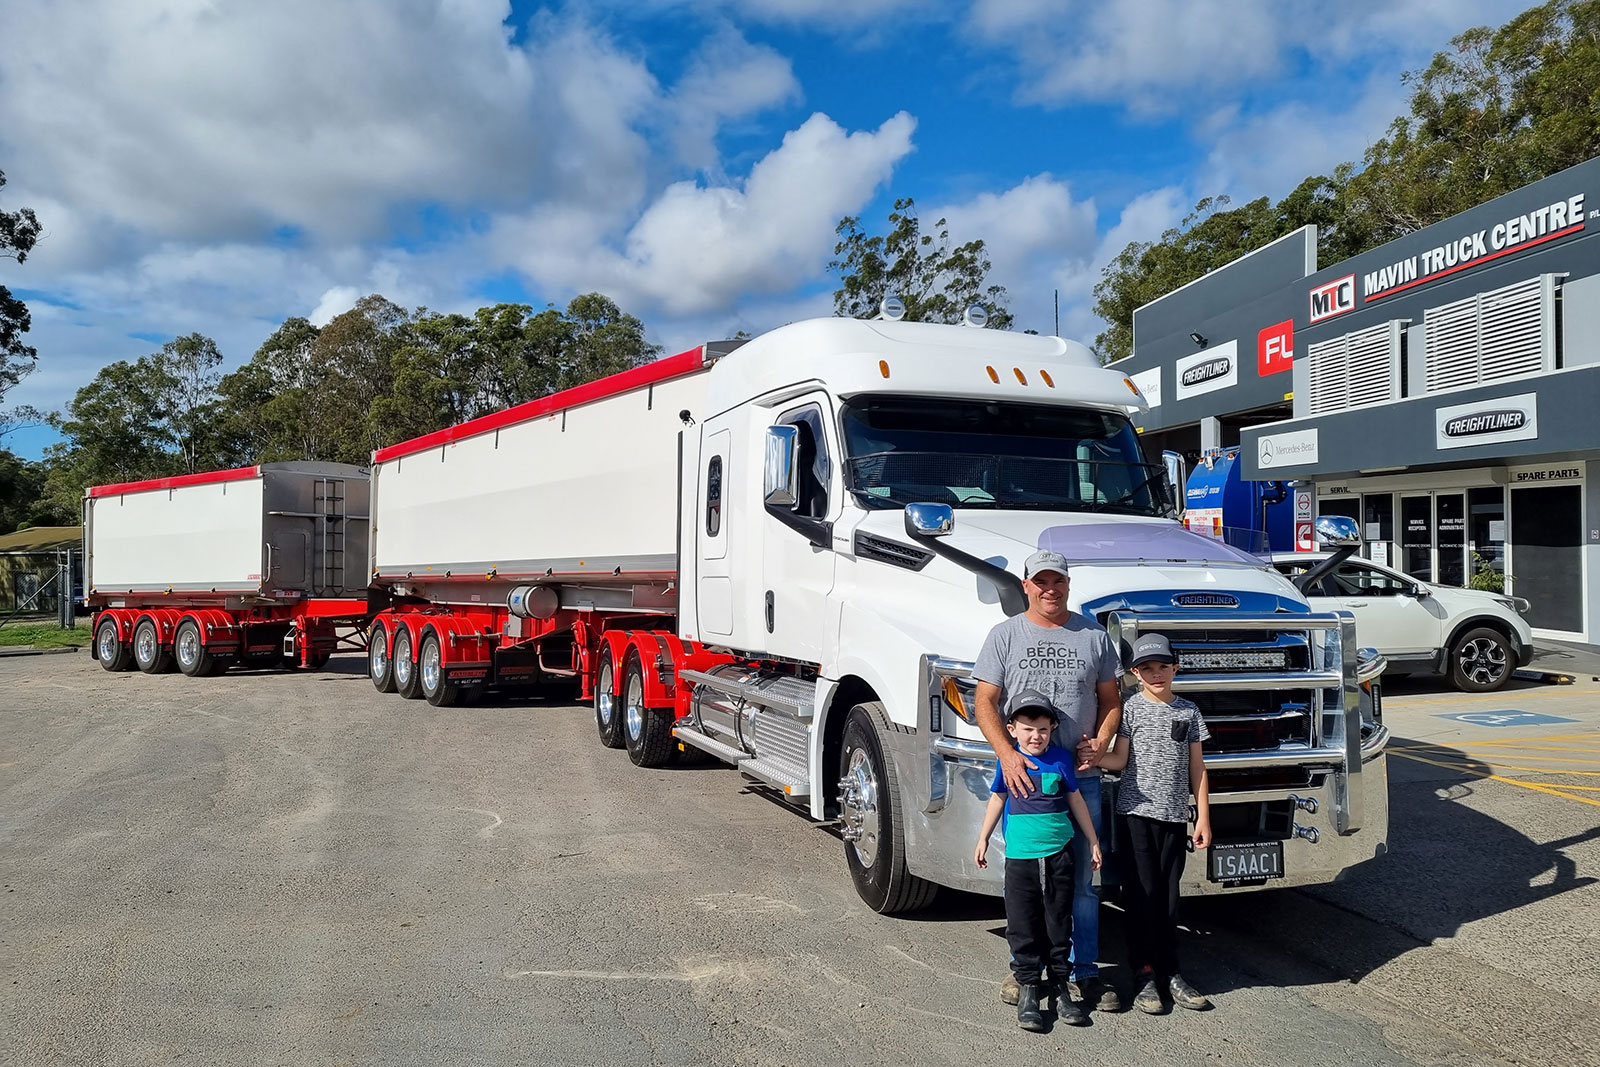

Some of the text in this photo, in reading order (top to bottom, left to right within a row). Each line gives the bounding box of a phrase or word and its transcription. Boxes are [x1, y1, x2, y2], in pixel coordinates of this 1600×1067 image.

[1364, 256, 1417, 296] MAVIN
[1422, 231, 1487, 275] TRUCK
[1491, 193, 1585, 250] CENTRE
[1312, 282, 1350, 318] MTC
[1183, 360, 1228, 384] FREIGHTLINER
[1448, 413, 1522, 434] FREIGHTLINER
[1275, 442, 1315, 455] Mercedes-Benz
[1517, 468, 1579, 480] SPARE PARTS
[1180, 595, 1234, 604] FREIGHTLINER
[1026, 647, 1078, 658] BEACH
[1018, 658, 1087, 670] COMBER
[1217, 852, 1277, 877] ISAAC1
